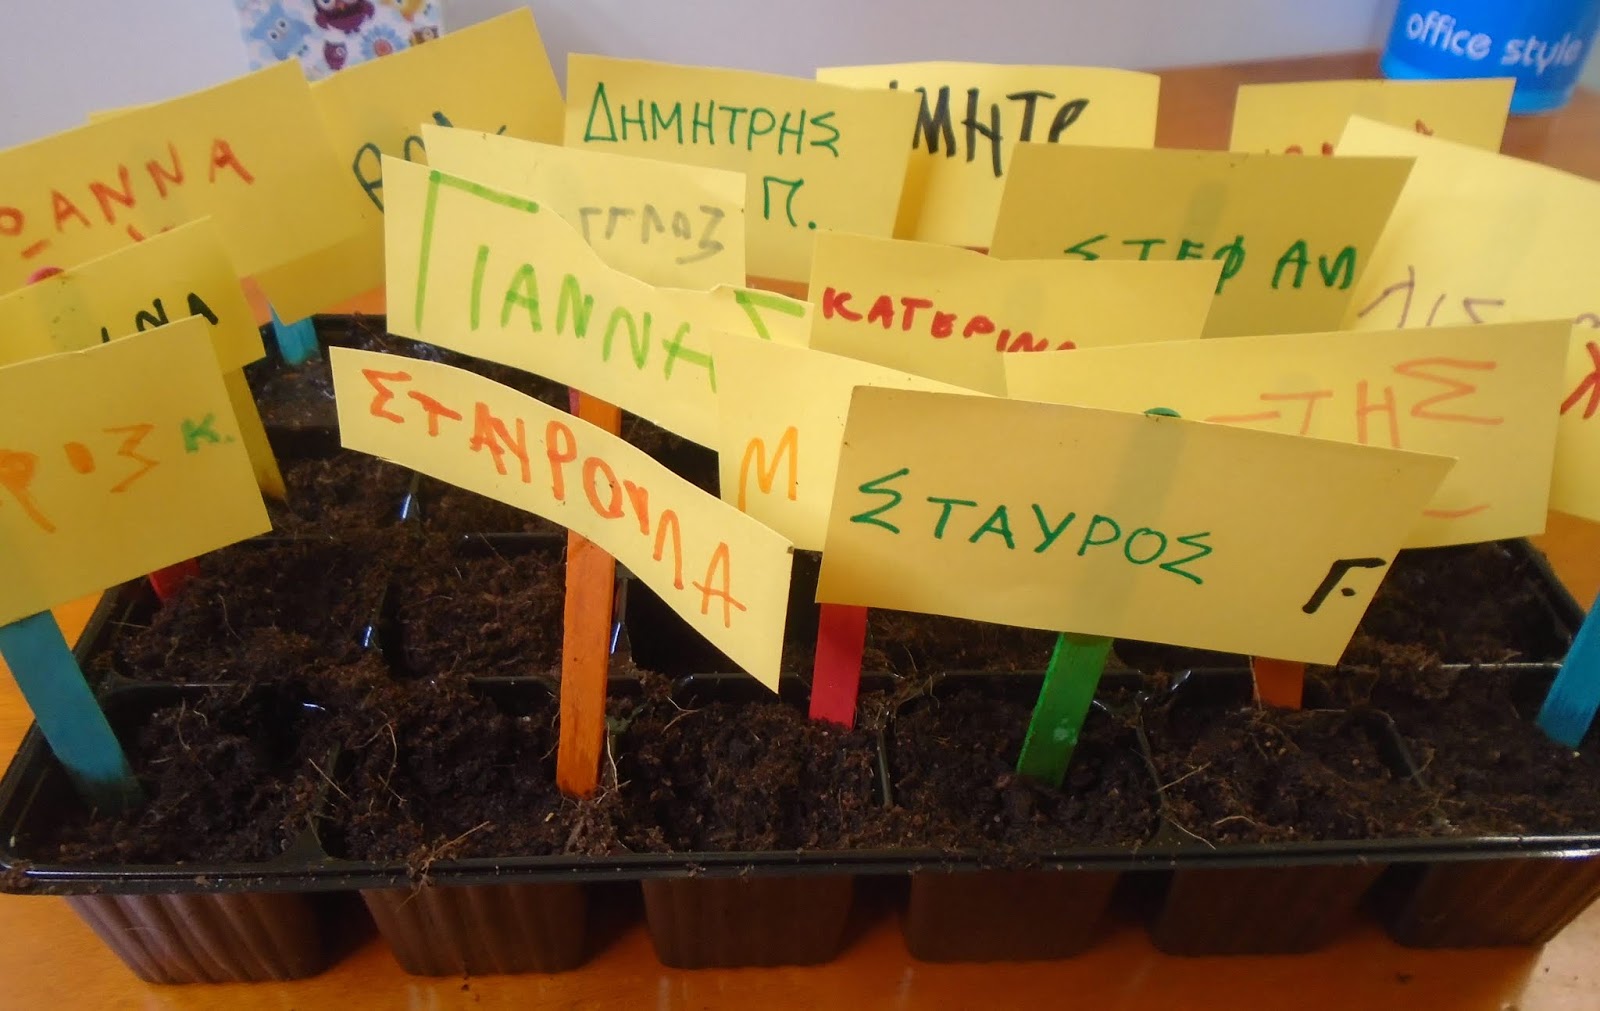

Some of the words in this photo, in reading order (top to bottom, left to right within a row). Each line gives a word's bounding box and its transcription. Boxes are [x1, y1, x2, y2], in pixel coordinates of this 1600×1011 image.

[1406, 10, 1492, 61] office
[1501, 33, 1583, 76] style
[583, 82, 840, 157] ΔΗΜΗΤΡΗΣ
[889, 80, 1090, 178] ΜΗΤΡ
[762, 176, 817, 230] Π.
[361, 367, 747, 628] ΣΤΑΥΡΟΥΛΑ
[850, 467, 1213, 585] ΣΤΑΥΡΟΣ
